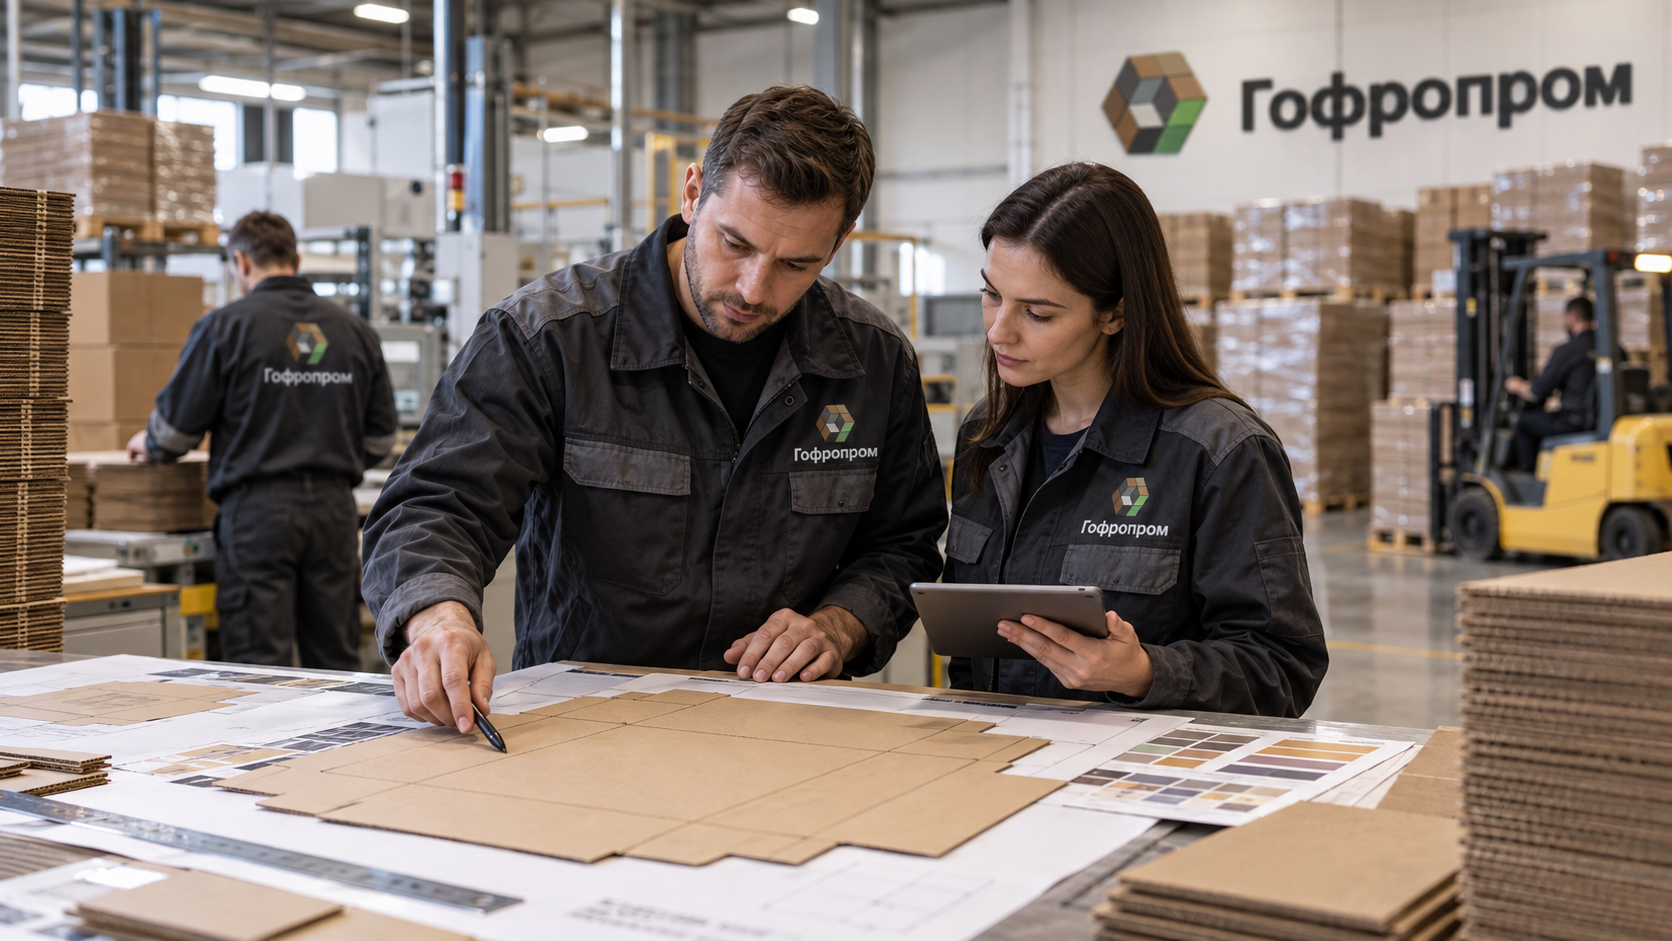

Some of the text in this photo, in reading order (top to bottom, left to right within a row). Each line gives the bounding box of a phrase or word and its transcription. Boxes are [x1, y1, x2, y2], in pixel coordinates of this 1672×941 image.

[1242, 63, 1632, 140] Гофропром
[264, 367, 353, 386] Гофропром
[794, 446, 878, 464] Гофропром
[1080, 520, 1169, 539] Гофропром
